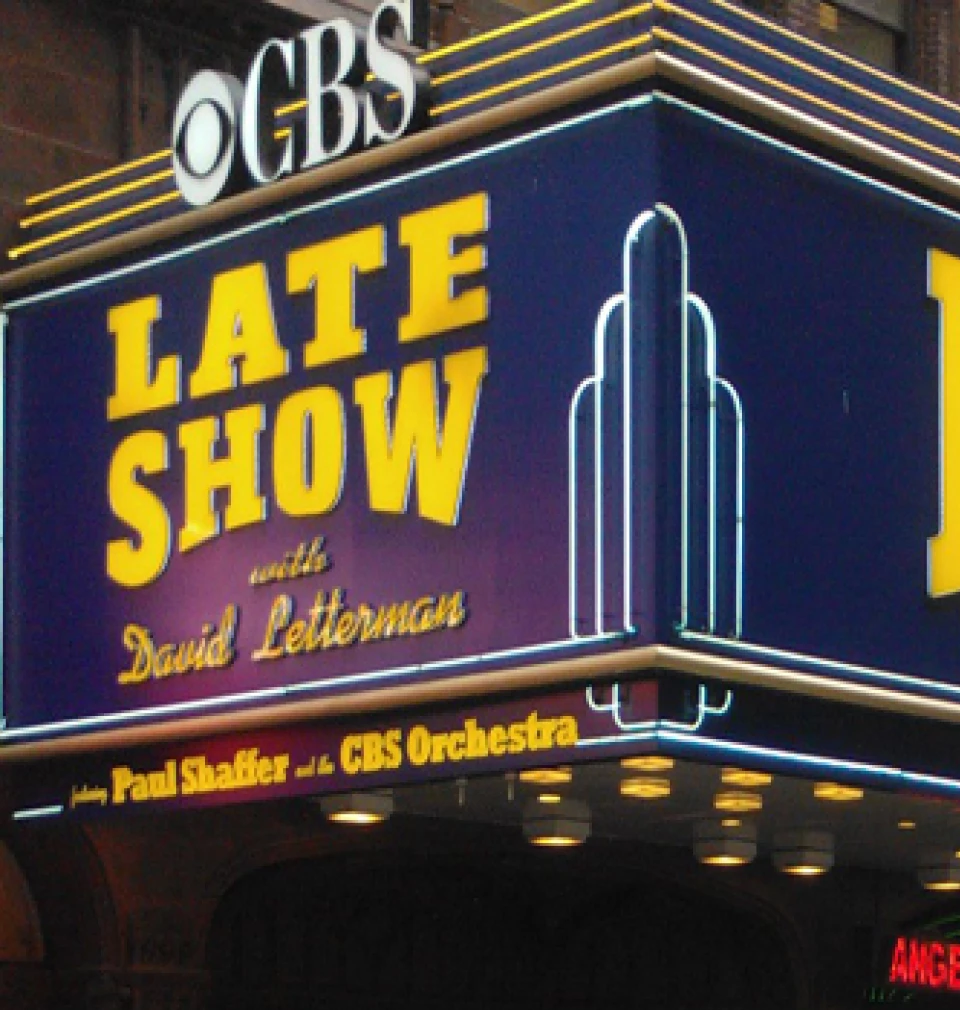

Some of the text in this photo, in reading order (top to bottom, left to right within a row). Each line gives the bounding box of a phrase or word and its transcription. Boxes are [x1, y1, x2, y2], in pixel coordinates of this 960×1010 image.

[242, 0, 416, 183] CBS
[107, 192, 490, 421] LATE
[106, 346, 490, 589] SHOW
[117, 586, 467, 685] David Letterman
[111, 758, 177, 804] Paul
[181, 747, 290, 796] Shaffer
[340, 727, 402, 775] CBS
[407, 709, 579, 767] Orchestra
